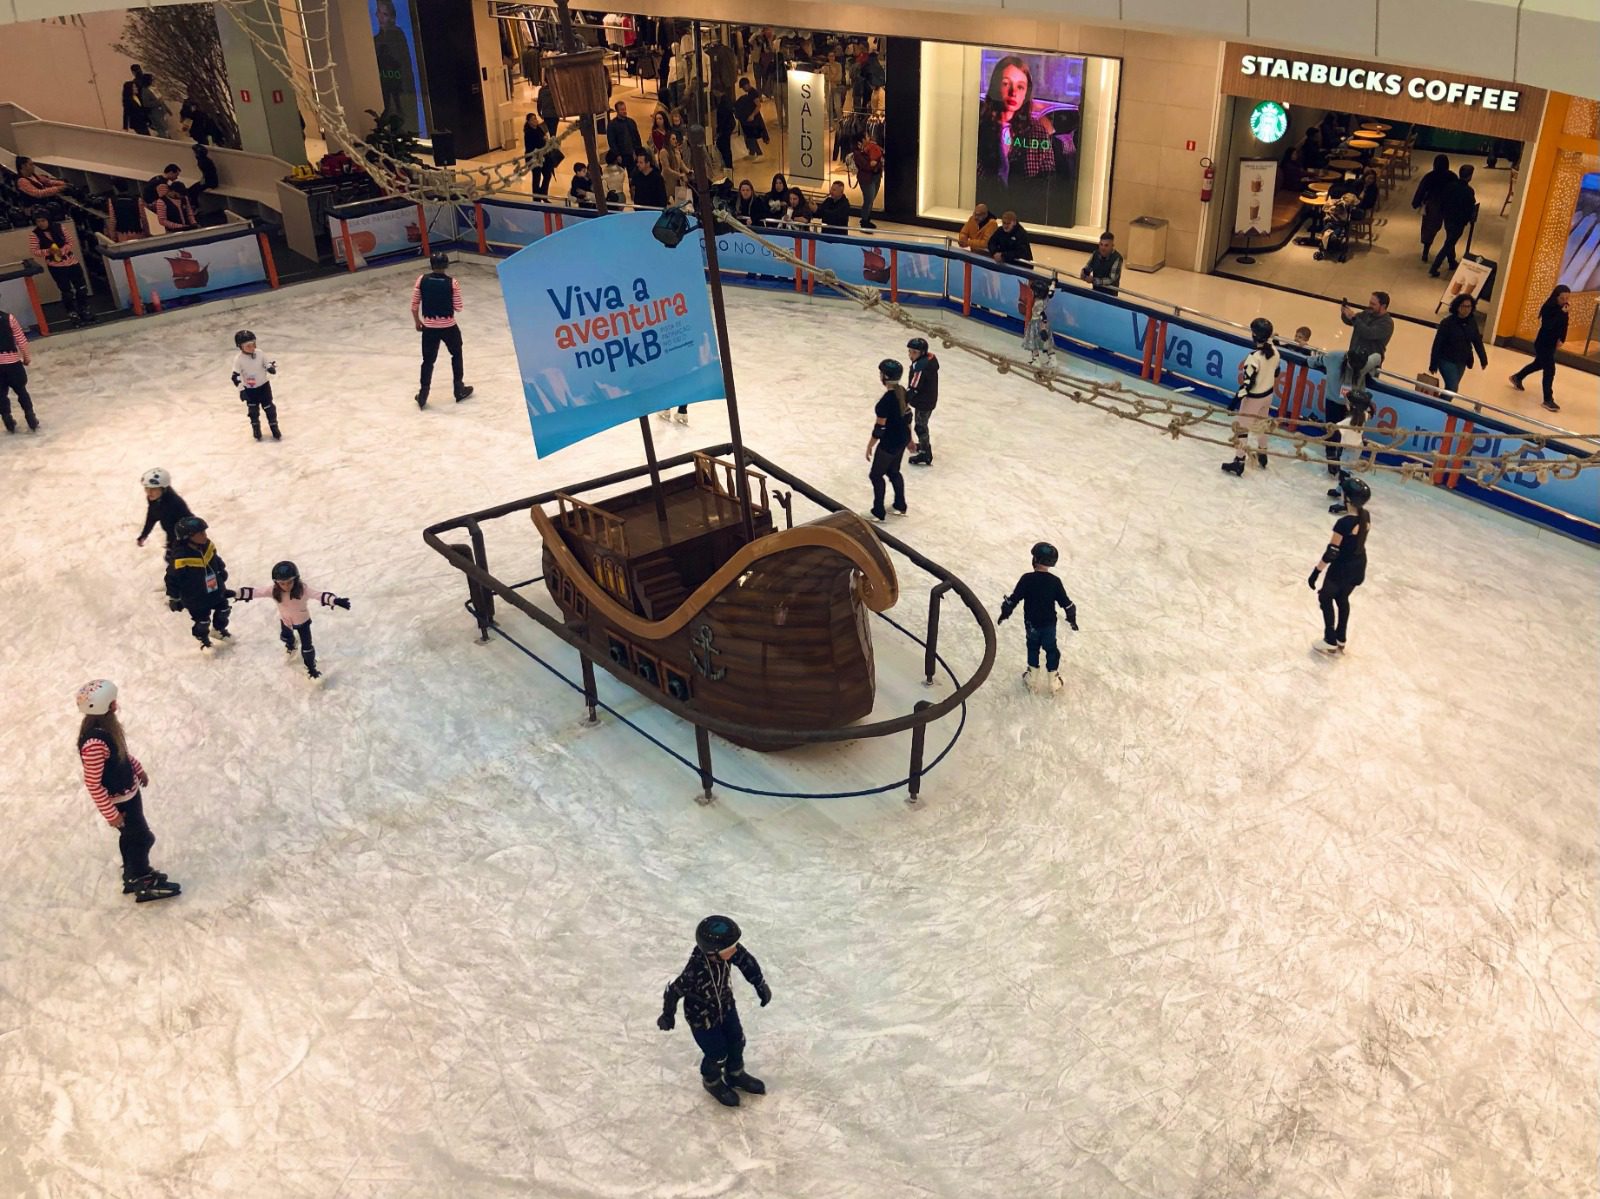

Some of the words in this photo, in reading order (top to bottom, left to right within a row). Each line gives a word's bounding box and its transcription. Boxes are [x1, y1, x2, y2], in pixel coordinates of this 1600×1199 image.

[1241, 55, 1402, 95] STARBUCKS
[1407, 77, 1519, 112] COFFEE
[800, 83, 813, 168] SALDO
[734, 241, 756, 255] NO
[546, 285, 625, 321] Viva
[632, 277, 650, 302] a
[554, 292, 688, 350] aventura
[1205, 349, 1224, 380] a
